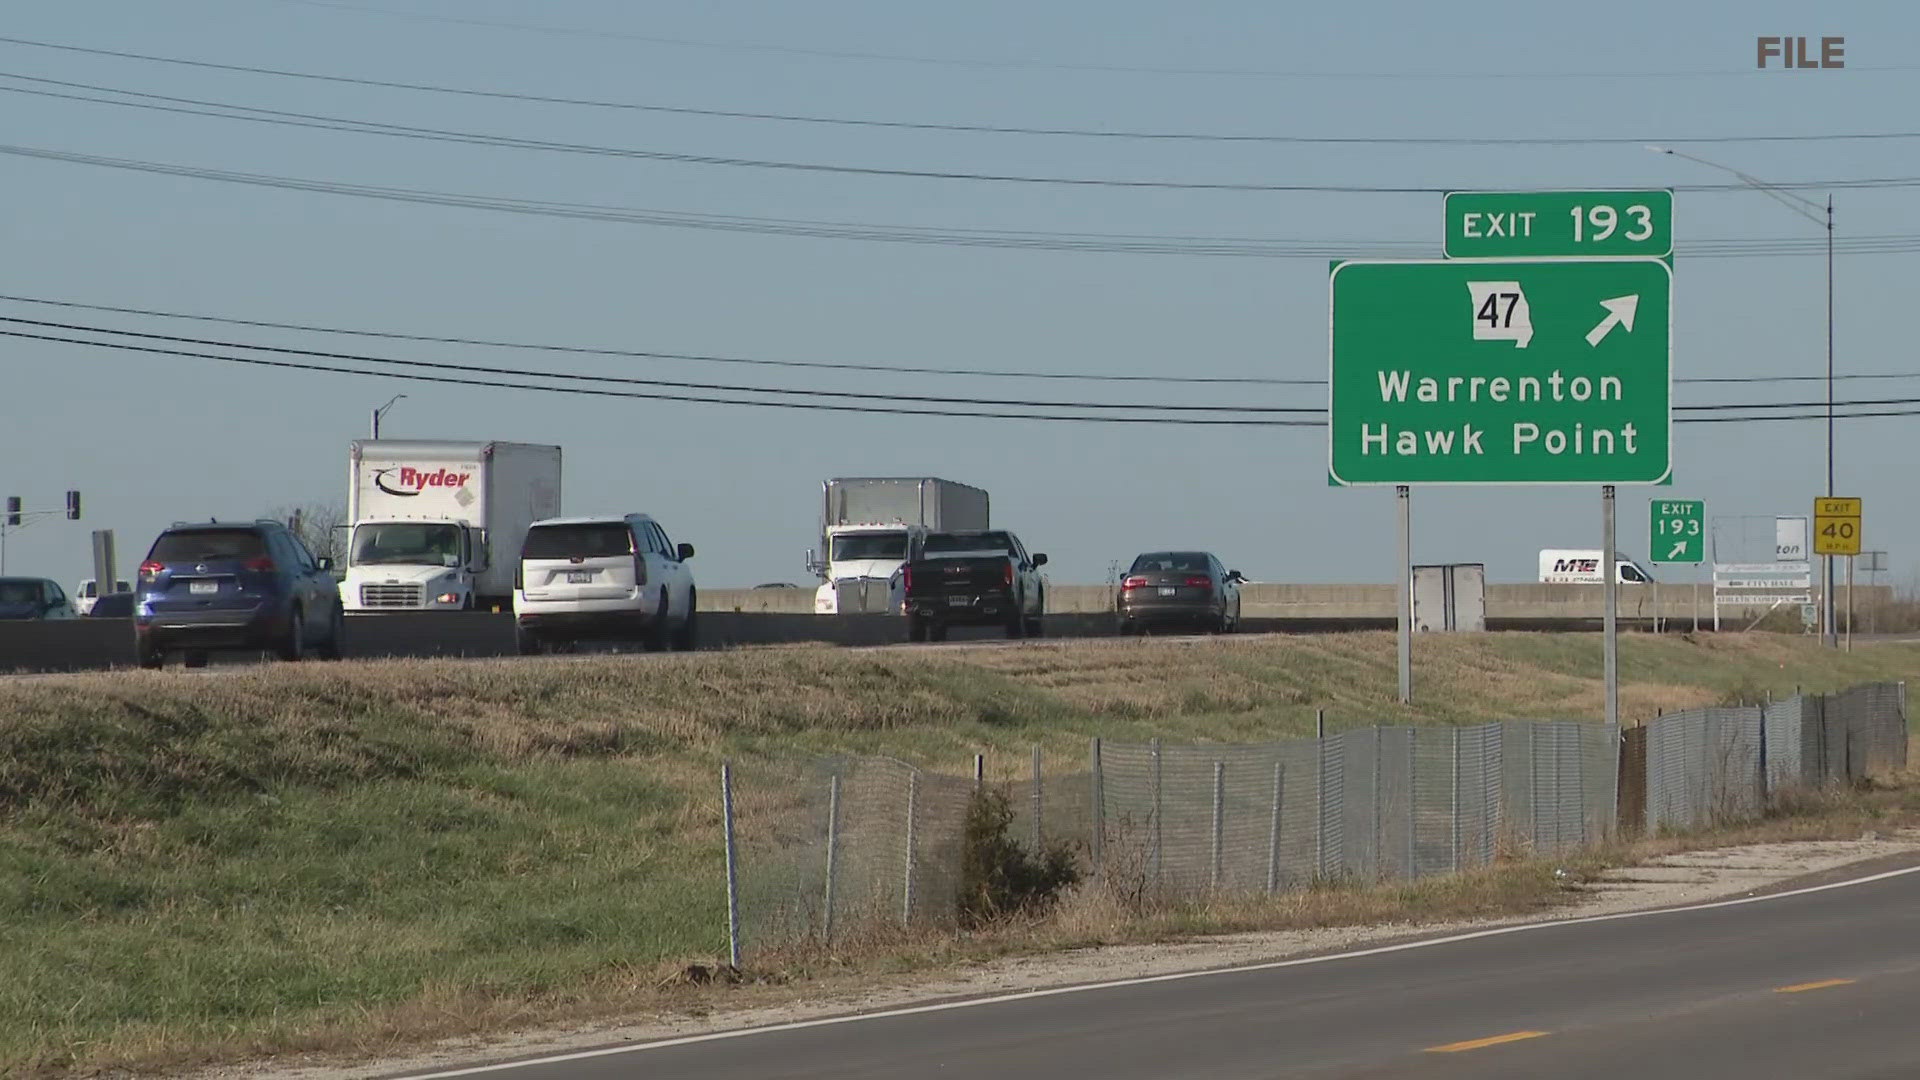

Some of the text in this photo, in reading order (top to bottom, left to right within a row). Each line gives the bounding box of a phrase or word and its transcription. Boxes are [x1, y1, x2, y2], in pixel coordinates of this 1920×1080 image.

[1463, 205, 1654, 242] EXIT 193
[1476, 293, 1521, 329] 47
[1377, 369, 1623, 403] Warrenton
[1360, 421, 1638, 455] Hawk Point
[400, 466, 470, 490] Ryder
[1661, 502, 1694, 515] EXIT
[1824, 503, 1851, 513] EXIT
[1658, 519, 1700, 536] 193
[1821, 522, 1854, 539] 40
